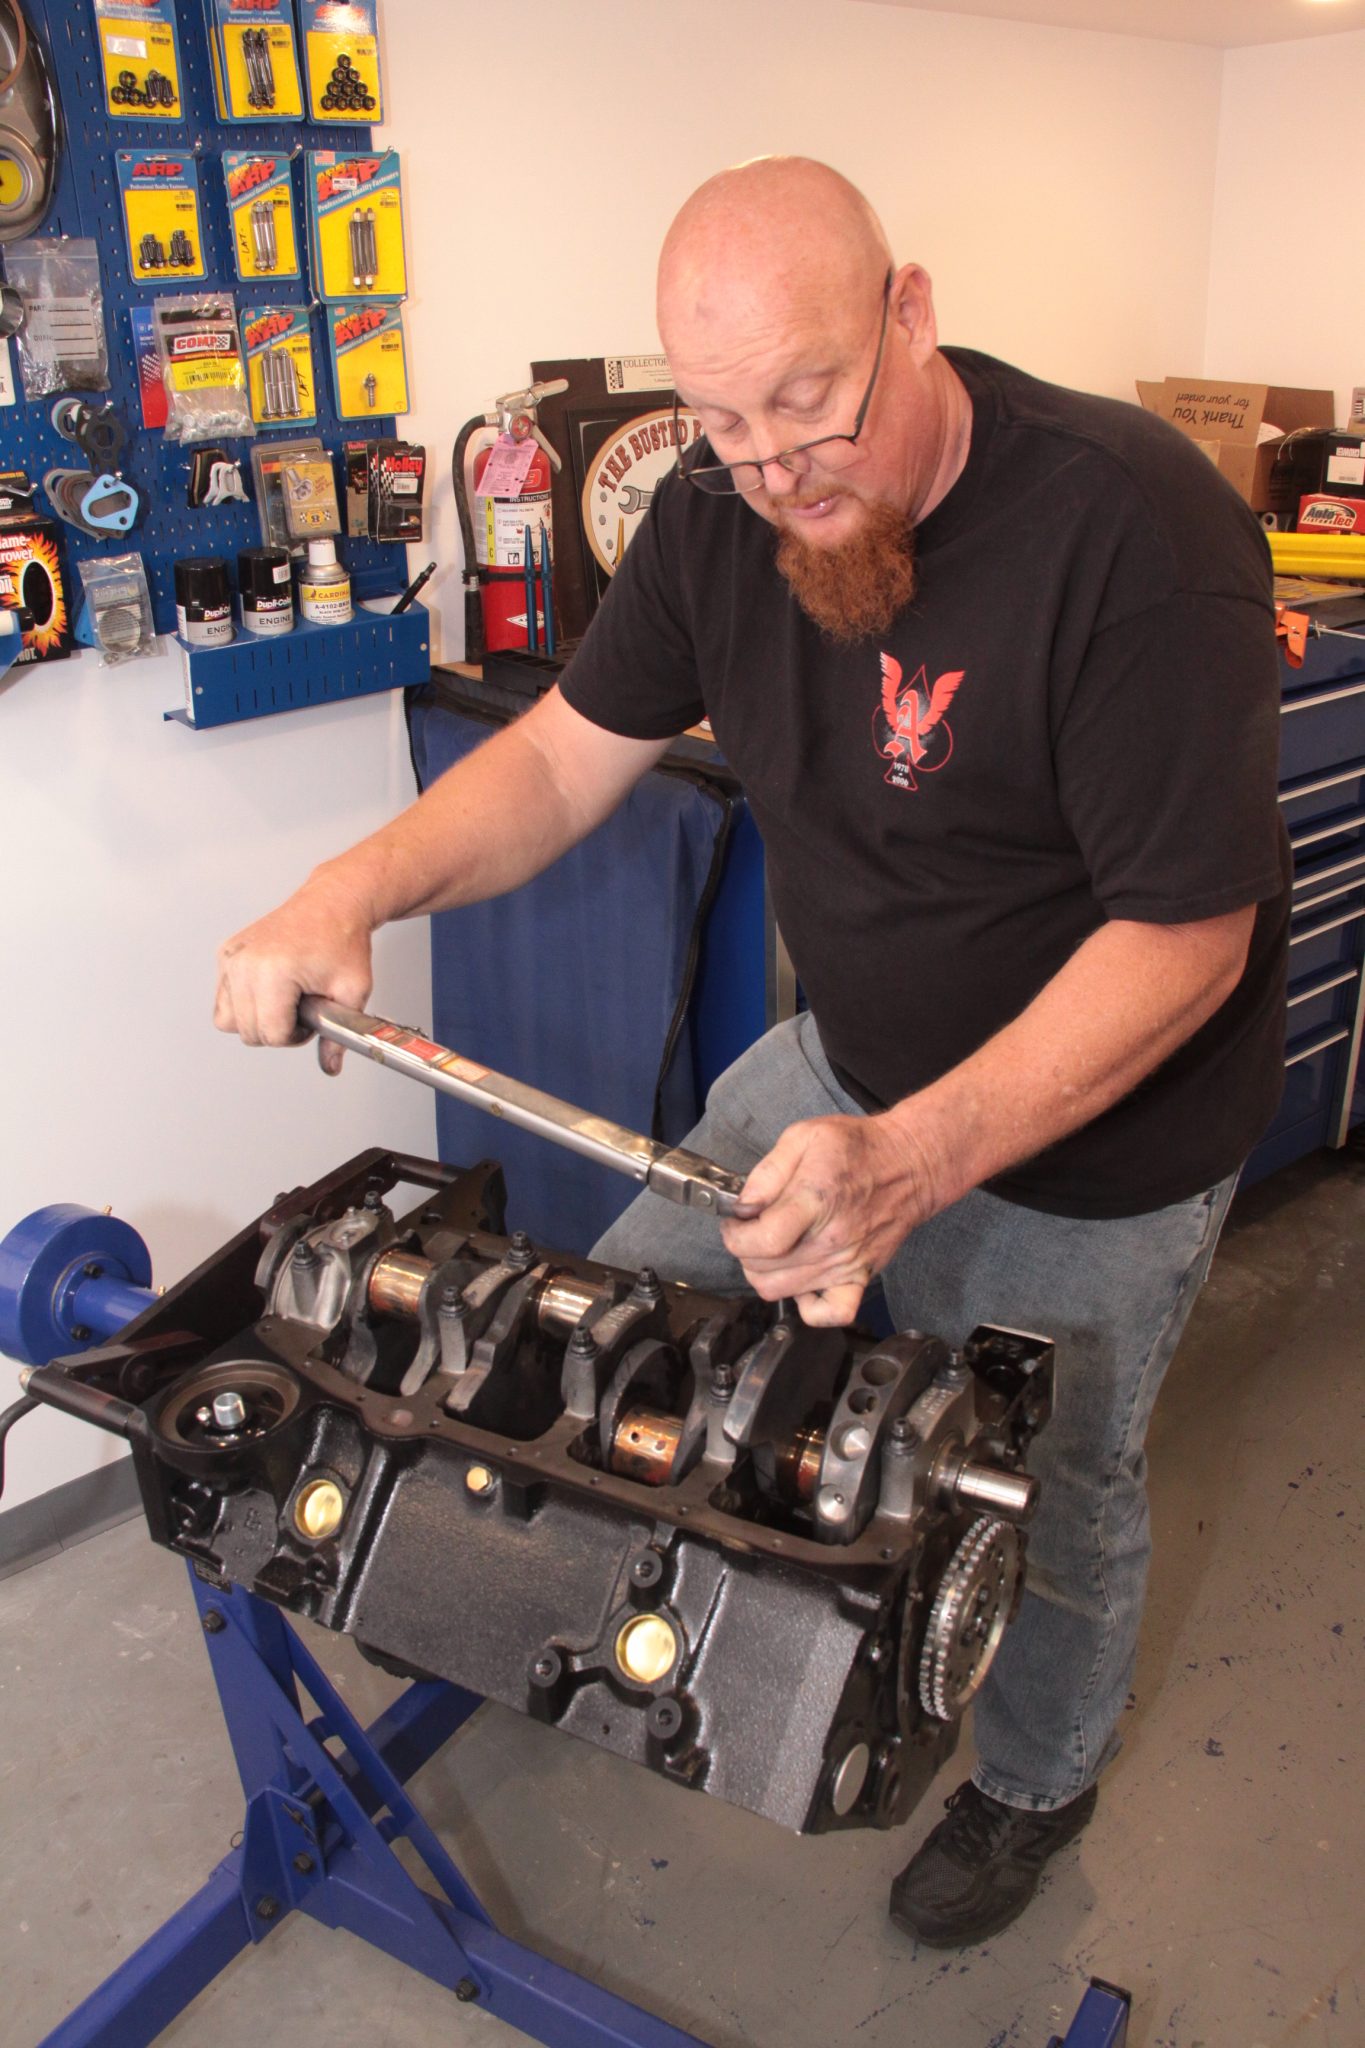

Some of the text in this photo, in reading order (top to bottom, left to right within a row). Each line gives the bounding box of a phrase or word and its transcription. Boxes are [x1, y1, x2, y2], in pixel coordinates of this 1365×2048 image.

[131, 162, 184, 177] ARP
[228, 159, 277, 200] ARP
[317, 192, 353, 213] Professional
[351, 182, 374, 202] Quality
[371, 170, 399, 189] Fasteners
[244, 312, 296, 350] ARP
[333, 308, 388, 348] ARP
[175, 335, 218, 351] COMP
[1206, 394, 1232, 405] your
[1233, 398, 1250, 410] for
[1172, 407, 1245, 429] Thank You
[597, 444, 633, 494] THE
[628, 418, 689, 462] BUSTED
[385, 455, 423, 477] Holley
[487, 501, 493, 512] A
[488, 524, 493, 535] B
[0, 534, 31, 550] ame-
[0, 549, 34, 564] rower
[489, 547, 494, 558] C
[259, 614, 292, 625] ENGINE
[207, 622, 231, 635] ENGIN
